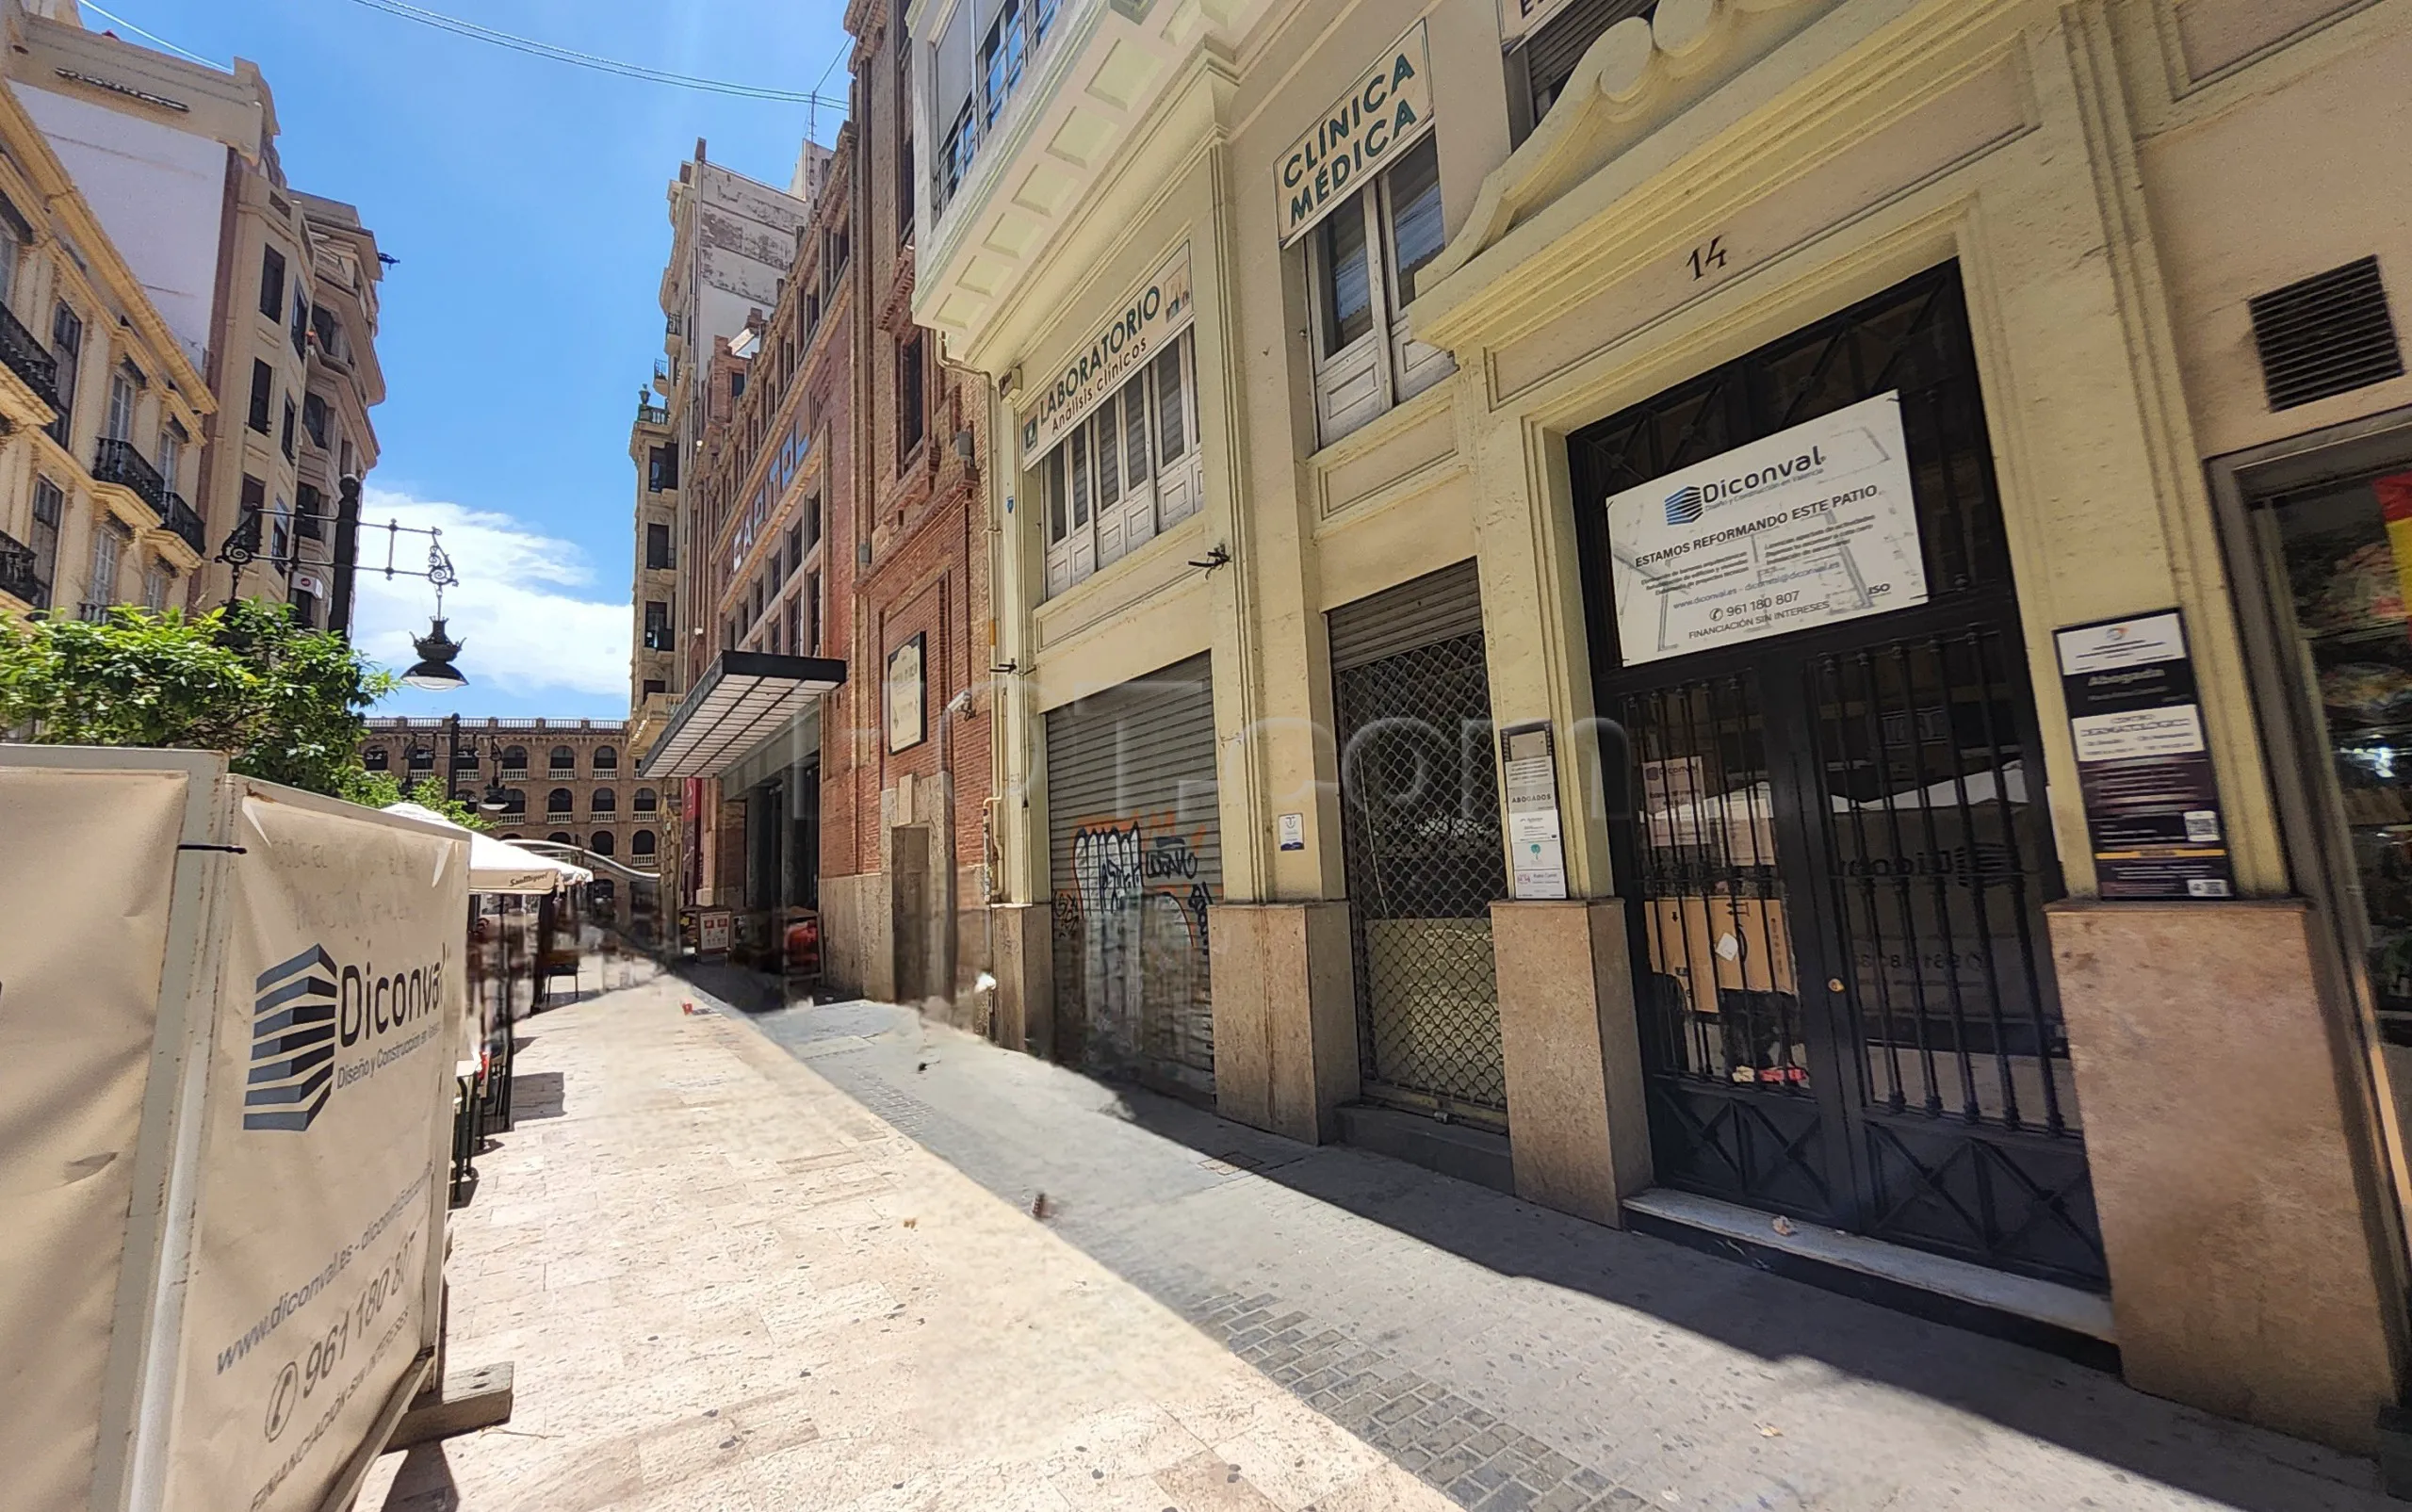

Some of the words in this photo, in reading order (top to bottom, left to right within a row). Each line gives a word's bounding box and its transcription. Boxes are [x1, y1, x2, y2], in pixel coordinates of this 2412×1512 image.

[1284, 53, 1415, 188] CLÍNICA
[1291, 99, 1417, 229] MÉDICA
[1686, 234, 1727, 282] 14
[1040, 285, 1160, 427] LABORATORIO
[1051, 388, 1093, 434] Análisis
[1096, 337, 1147, 392] clínicos
[1703, 446, 1821, 503] Diconval
[1636, 542, 1690, 567] ESTAMOS
[1693, 512, 1788, 550] REFORMANDO
[1792, 498, 1829, 520] ESTE
[1832, 485, 1878, 509] PATIO
[1688, 618, 1753, 639] FINANCIACIÓN
[1756, 613, 1772, 624] SIN
[1774, 601, 1830, 620] INTERESES
[1726, 603, 1747, 617] 961
[1750, 597, 1772, 612] 180
[1775, 591, 1800, 606] 807
[1867, 583, 1891, 595] ISO
[1511, 793, 1552, 805] ABOGADOS
[337, 1057, 369, 1090] Diseño
[218, 1244, 352, 1375] www.diconval.es
[303, 1310, 350, 1400] 961
[356, 1268, 390, 1340] 180
